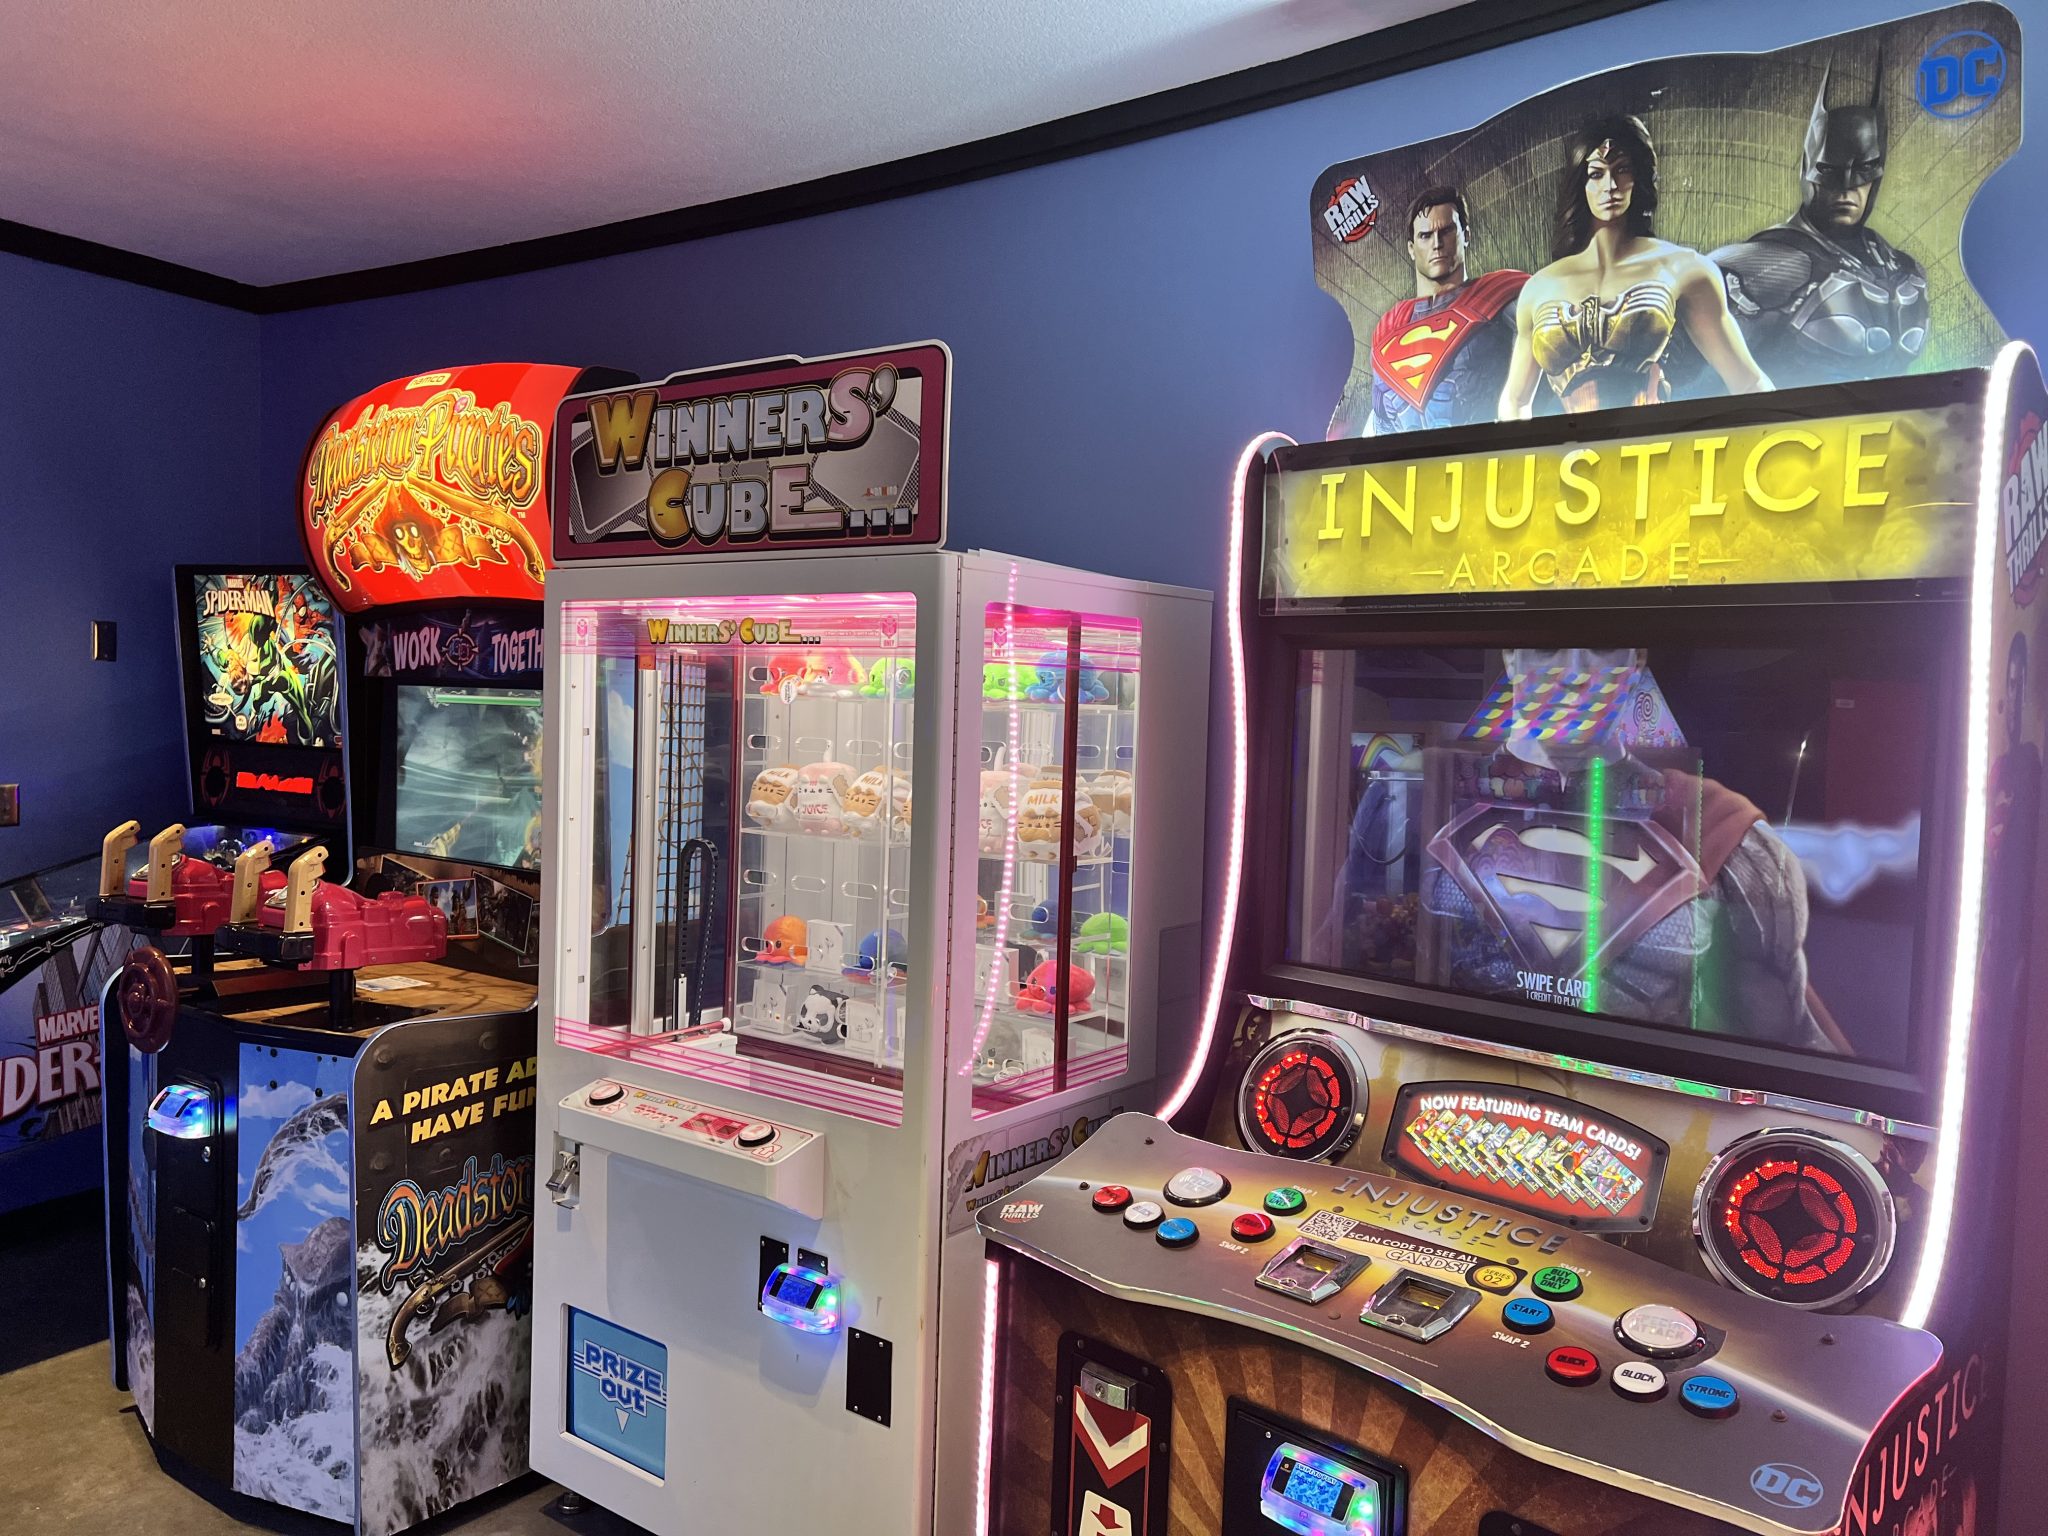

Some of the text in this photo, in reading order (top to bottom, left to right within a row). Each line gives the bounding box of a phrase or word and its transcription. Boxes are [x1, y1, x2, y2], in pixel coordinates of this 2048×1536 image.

[1918, 44, 2002, 106] DC
[1323, 175, 1374, 232] RAW
[1333, 194, 1379, 243] THRILLS
[417, 392, 542, 506] Pirates
[1317, 420, 1893, 541] INJUSTICE
[1449, 542, 1691, 588] ARCADE
[203, 589, 275, 617] SPIDER-MAN
[394, 626, 544, 673] WORK TOGETH
[802, 804, 829, 815] JUICE
[1027, 795, 1059, 805] MILK
[1516, 971, 1592, 999] SWIPE CARD
[1530, 991, 1552, 1003] CREDIT
[1553, 994, 1562, 1005] TO
[1563, 997, 1581, 1008] PLAY
[39, 1005, 99, 1043] MARVE
[369, 1056, 537, 1126] A PIRATE AD
[411, 1101, 485, 1144] HAVE
[1420, 1096, 1643, 1161] NOW FEATURING TEAM CARDS!
[379, 1154, 535, 1290] Deadstor
[1000, 1211, 1040, 1219] THRILLS
[1001, 1203, 1044, 1213] RAW
[1332, 1176, 1572, 1256] INJUSTICE
[1219, 1240, 1242, 1253] SWAP
[1347, 1232, 1478, 1264] SCAN CODE TO SEE ALL
[1386, 1249, 1472, 1275] CARDS!
[1484, 1268, 1511, 1281] SERIES
[1550, 1268, 1572, 1278] BUY
[1483, 1275, 1503, 1286] 02
[1540, 1280, 1566, 1290] ONLY
[1543, 1274, 1571, 1285] CARD
[1511, 1304, 1543, 1317] START
[1492, 1331, 1530, 1349] SWAP 2
[585, 1341, 662, 1398] PRIZE
[1555, 1354, 1588, 1367] QUICK
[1620, 1369, 1657, 1383] BLOCK
[1686, 1383, 1731, 1398] STRONG
[1753, 1464, 1821, 1506] DC
